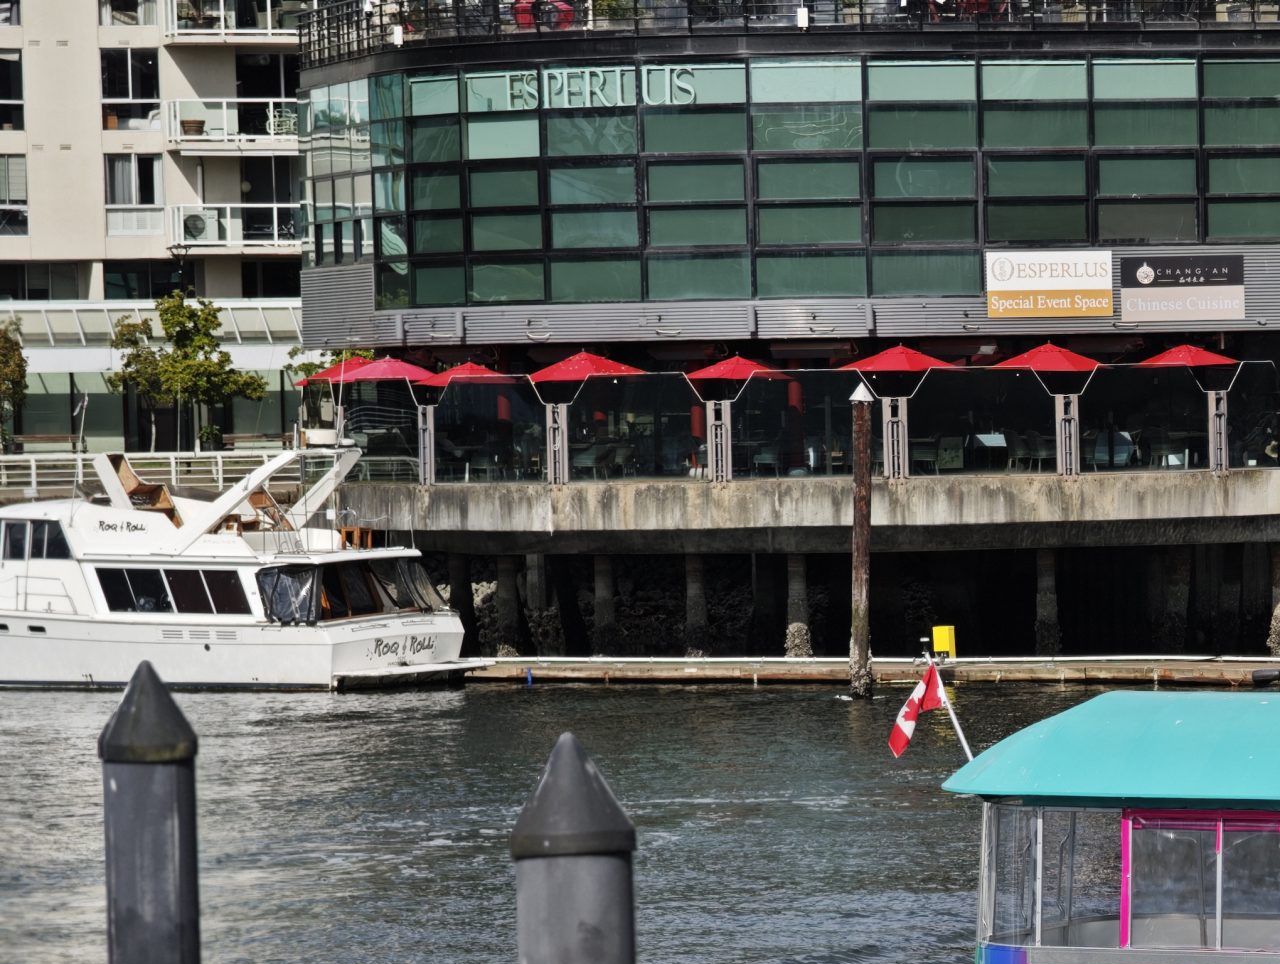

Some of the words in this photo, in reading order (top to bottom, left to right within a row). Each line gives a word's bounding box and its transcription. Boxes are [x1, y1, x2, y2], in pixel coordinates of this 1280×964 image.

[505, 66, 697, 110] ESPERLUS
[1016, 260, 1109, 279] ESPERLUS
[1156, 267, 1229, 276] CHANG'AN
[991, 295, 1034, 311] Special
[1037, 296, 1073, 309] Event
[1075, 294, 1110, 310] Space
[1126, 297, 1183, 312] Chinese
[1186, 295, 1241, 310] Cuisine
